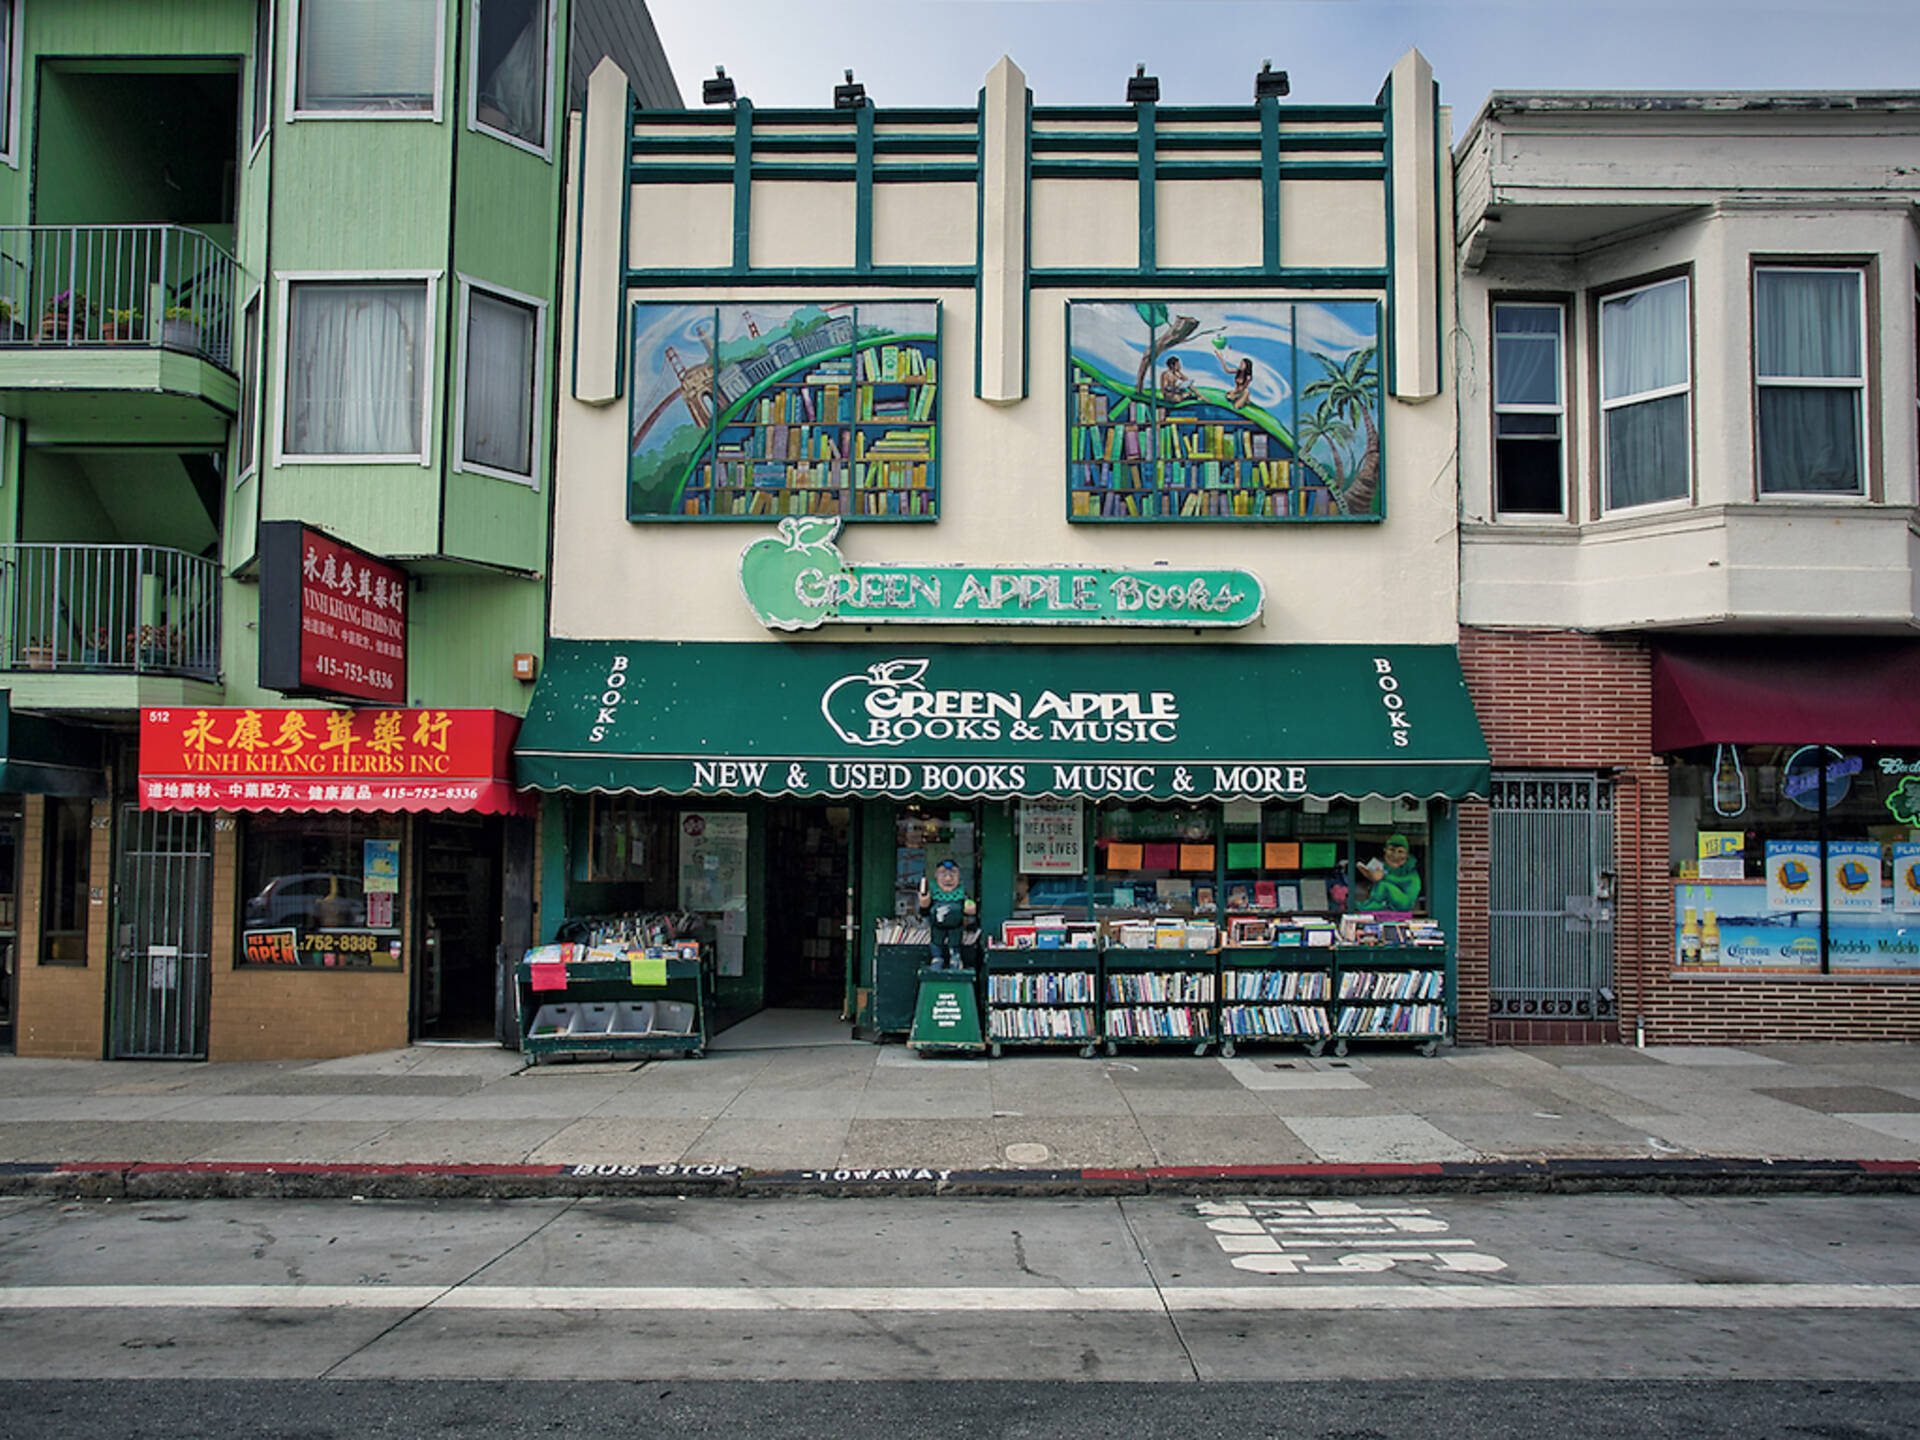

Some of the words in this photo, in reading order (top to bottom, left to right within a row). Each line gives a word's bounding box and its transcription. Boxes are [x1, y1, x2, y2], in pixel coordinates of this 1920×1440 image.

[795, 568, 941, 608] GREEN
[953, 574, 1102, 610] APPLE
[316, 655, 393, 689] 415-752-8336
[589, 656, 628, 742] BOOKS
[864, 688, 1021, 719] GREEN
[1028, 690, 1180, 720] APPLE
[1373, 658, 1412, 746] BOOKS
[149, 711, 170, 722] 512
[867, 719, 1002, 740] BOOKS
[1009, 719, 1044, 740] &
[1050, 720, 1177, 741] MUSIC
[183, 753, 239, 771] VINH
[246, 753, 326, 773] KHANG
[331, 753, 405, 773] HERBS
[410, 753, 450, 774] INC
[693, 761, 768, 787] NEW
[786, 763, 809, 789] &
[827, 764, 912, 789] USED
[921, 765, 1026, 790] BOOKS
[1053, 766, 1155, 792] MUSIC
[1172, 766, 1194, 792] &
[1213, 766, 1307, 793] MORE
[382, 787, 478, 800] 415-752-8336
[1024, 822, 1073, 836] MEASURE
[1026, 842, 1047, 854] OUR
[1050, 842, 1079, 855] LIVES
[1769, 844, 1793, 853] PLAY
[1795, 844, 1818, 853] NOW
[1830, 845, 1854, 853] PLAY
[1856, 846, 1879, 854] NOW
[248, 945, 295, 963] OPEN
[1727, 943, 1770, 957] Corona
[1878, 939, 1919, 954] Modelo
[572, 1164, 640, 1176] BUS
